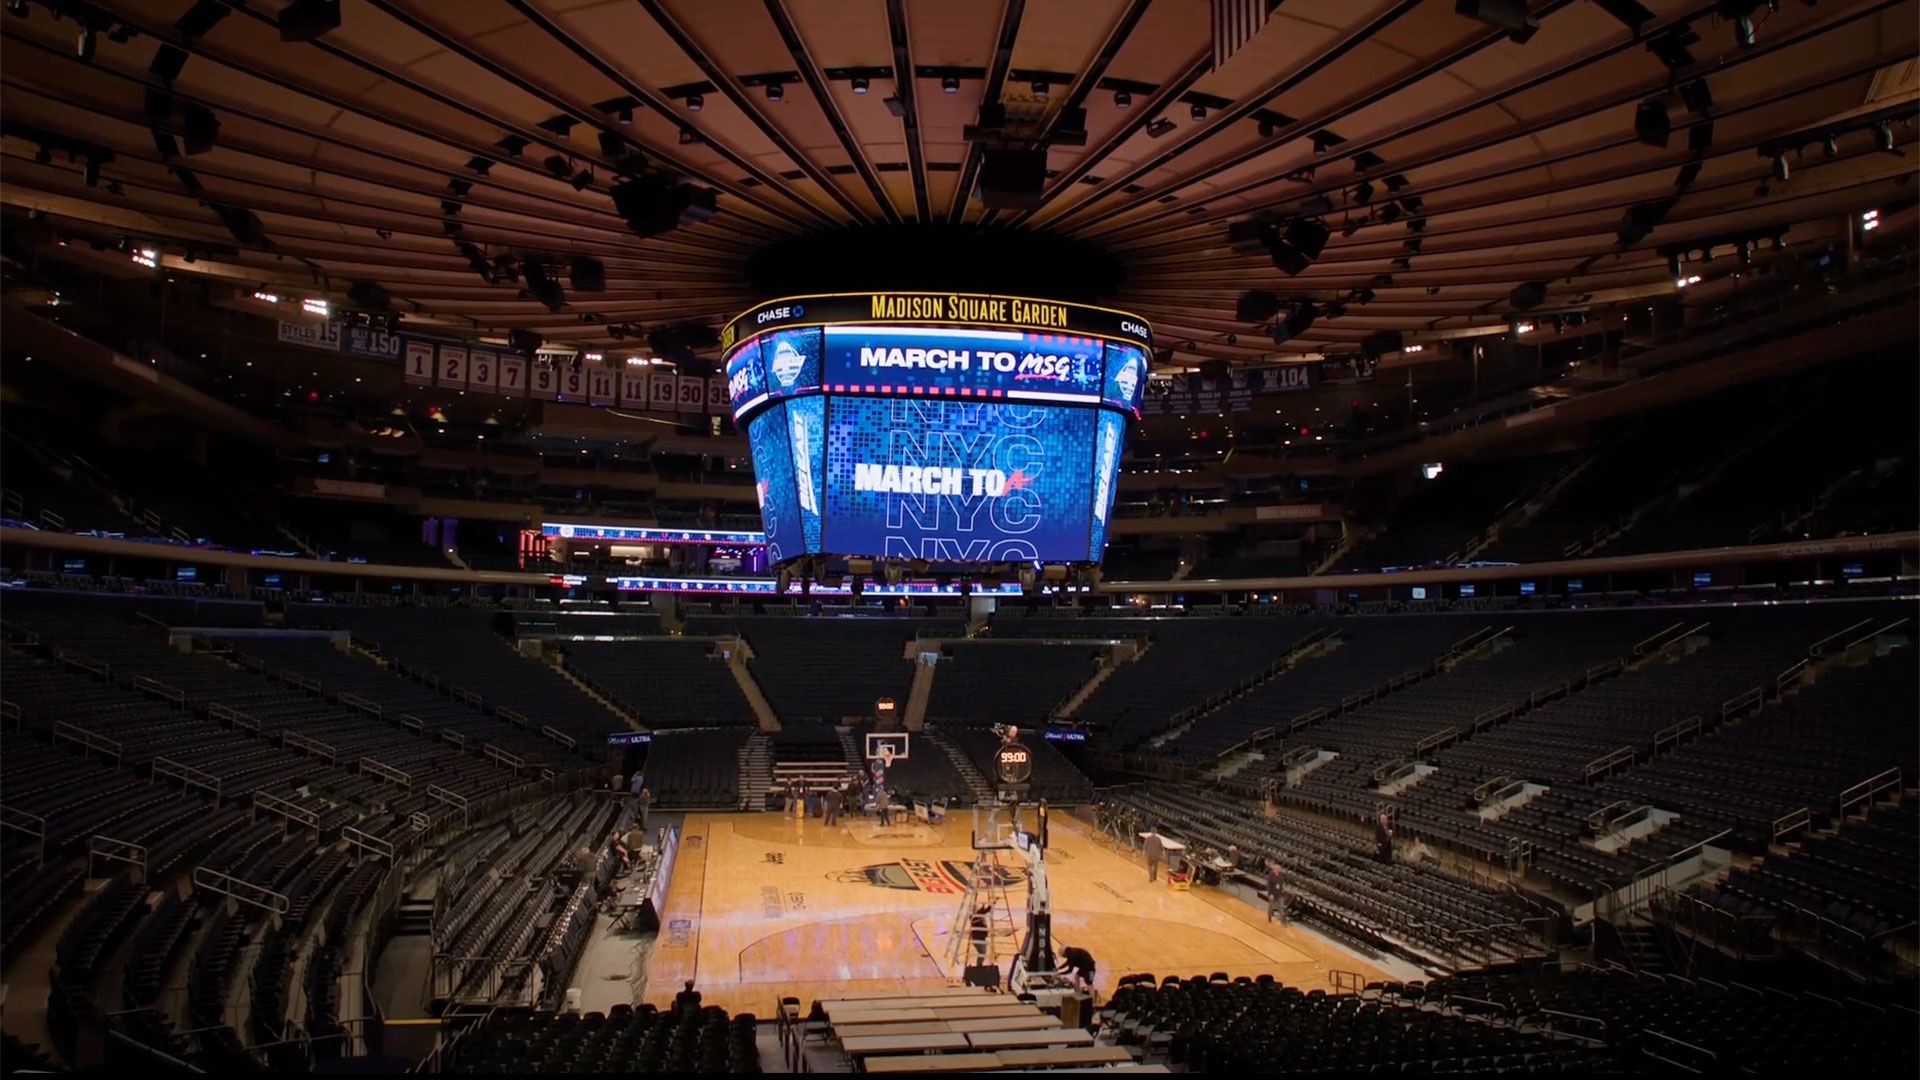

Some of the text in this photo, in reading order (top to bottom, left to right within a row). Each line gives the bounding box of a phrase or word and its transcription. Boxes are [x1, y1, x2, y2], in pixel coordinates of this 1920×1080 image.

[757, 307, 790, 324] CHASE
[872, 295, 1067, 327] MADISON SQUARE GARDEN
[281, 324, 316, 339] STYLES
[320, 322, 338, 343] 15
[1121, 321, 1148, 339] CHASE
[369, 331, 400, 355] 150
[414, 355, 422, 375] 1
[447, 359, 458, 379] 2
[477, 364, 488, 383] 3
[861, 347, 1070, 381] MARCH TO MSG
[507, 367, 518, 386] 7
[539, 371, 549, 389] 9
[569, 375, 579, 393] 9
[1280, 366, 1309, 389] 104
[595, 377, 610, 396] 11
[626, 381, 641, 400] 11
[654, 383, 672, 401] 19
[680, 384, 701, 403] 30
[710, 386, 730, 405] 35
[889, 430, 1044, 482] NYC
[854, 463, 1006, 497] MARCH TO
[886, 486, 1042, 534] NYC
[1001, 752, 1027, 763] 99:00
